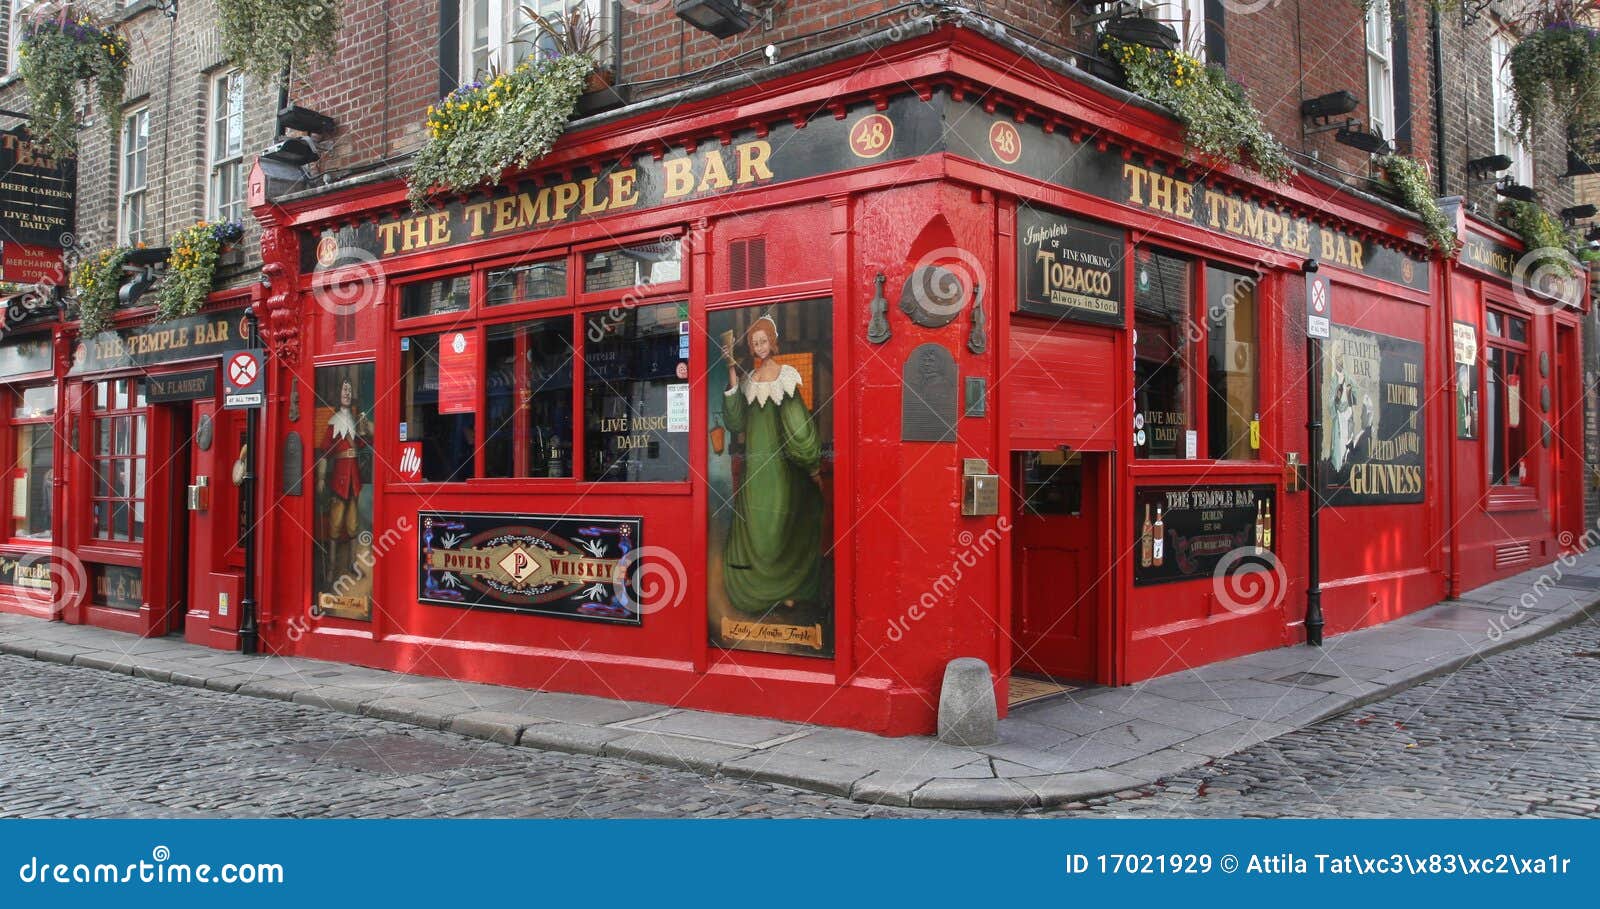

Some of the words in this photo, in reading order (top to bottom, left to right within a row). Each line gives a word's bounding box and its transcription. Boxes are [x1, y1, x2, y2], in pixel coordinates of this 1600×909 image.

[857, 124, 885, 151] 48
[996, 127, 1016, 154] 48
[17, 150, 57, 170] BAR
[1, 182, 28, 193] BEER
[31, 186, 72, 199] GARDEN
[379, 210, 452, 254] THE
[464, 169, 641, 237] TEMPLE
[663, 140, 774, 198] BAR
[4, 210, 30, 221] LIVE
[32, 214, 66, 226] MUSIC
[20, 220, 51, 231] DAILY
[1123, 163, 1194, 219] THE
[1205, 191, 1310, 253] TEMPLE
[1320, 228, 1364, 269] BAR
[1024, 224, 1068, 248] Importers
[1052, 240, 1060, 248] OF
[25, 250, 44, 258] BAR
[1063, 248, 1079, 261] FINE
[1080, 253, 1111, 268] SMOKING
[1036, 249, 1111, 297] TOBACCO
[1052, 293, 1081, 306] Always
[1084, 298, 1092, 306] in
[1095, 299, 1117, 312] Stock
[95, 338, 124, 360] THE
[127, 328, 189, 354] TEMPLE
[194, 320, 229, 345] BAR
[1342, 339, 1379, 361] TEMPLE
[1353, 359, 1371, 378] BAR
[1404, 363, 1417, 383] THE
[600, 418, 627, 433] LIVE
[631, 415, 667, 431] MUSIC
[1144, 411, 1163, 424] LIVE
[618, 434, 651, 449] DAILY
[1155, 428, 1178, 441] DAILY
[400, 447, 421, 479] illy
[1350, 463, 1422, 495] GUINNESS
[1166, 491, 1190, 509] THE
[1191, 490, 1233, 509] TEMPLE
[1235, 490, 1255, 506] BAR
[444, 553, 490, 570] POWERS
[514, 552, 528, 577] P
[550, 558, 613, 578] WHISKEY
[730, 623, 751, 638] Lady
[783, 627, 810, 640] Temple
